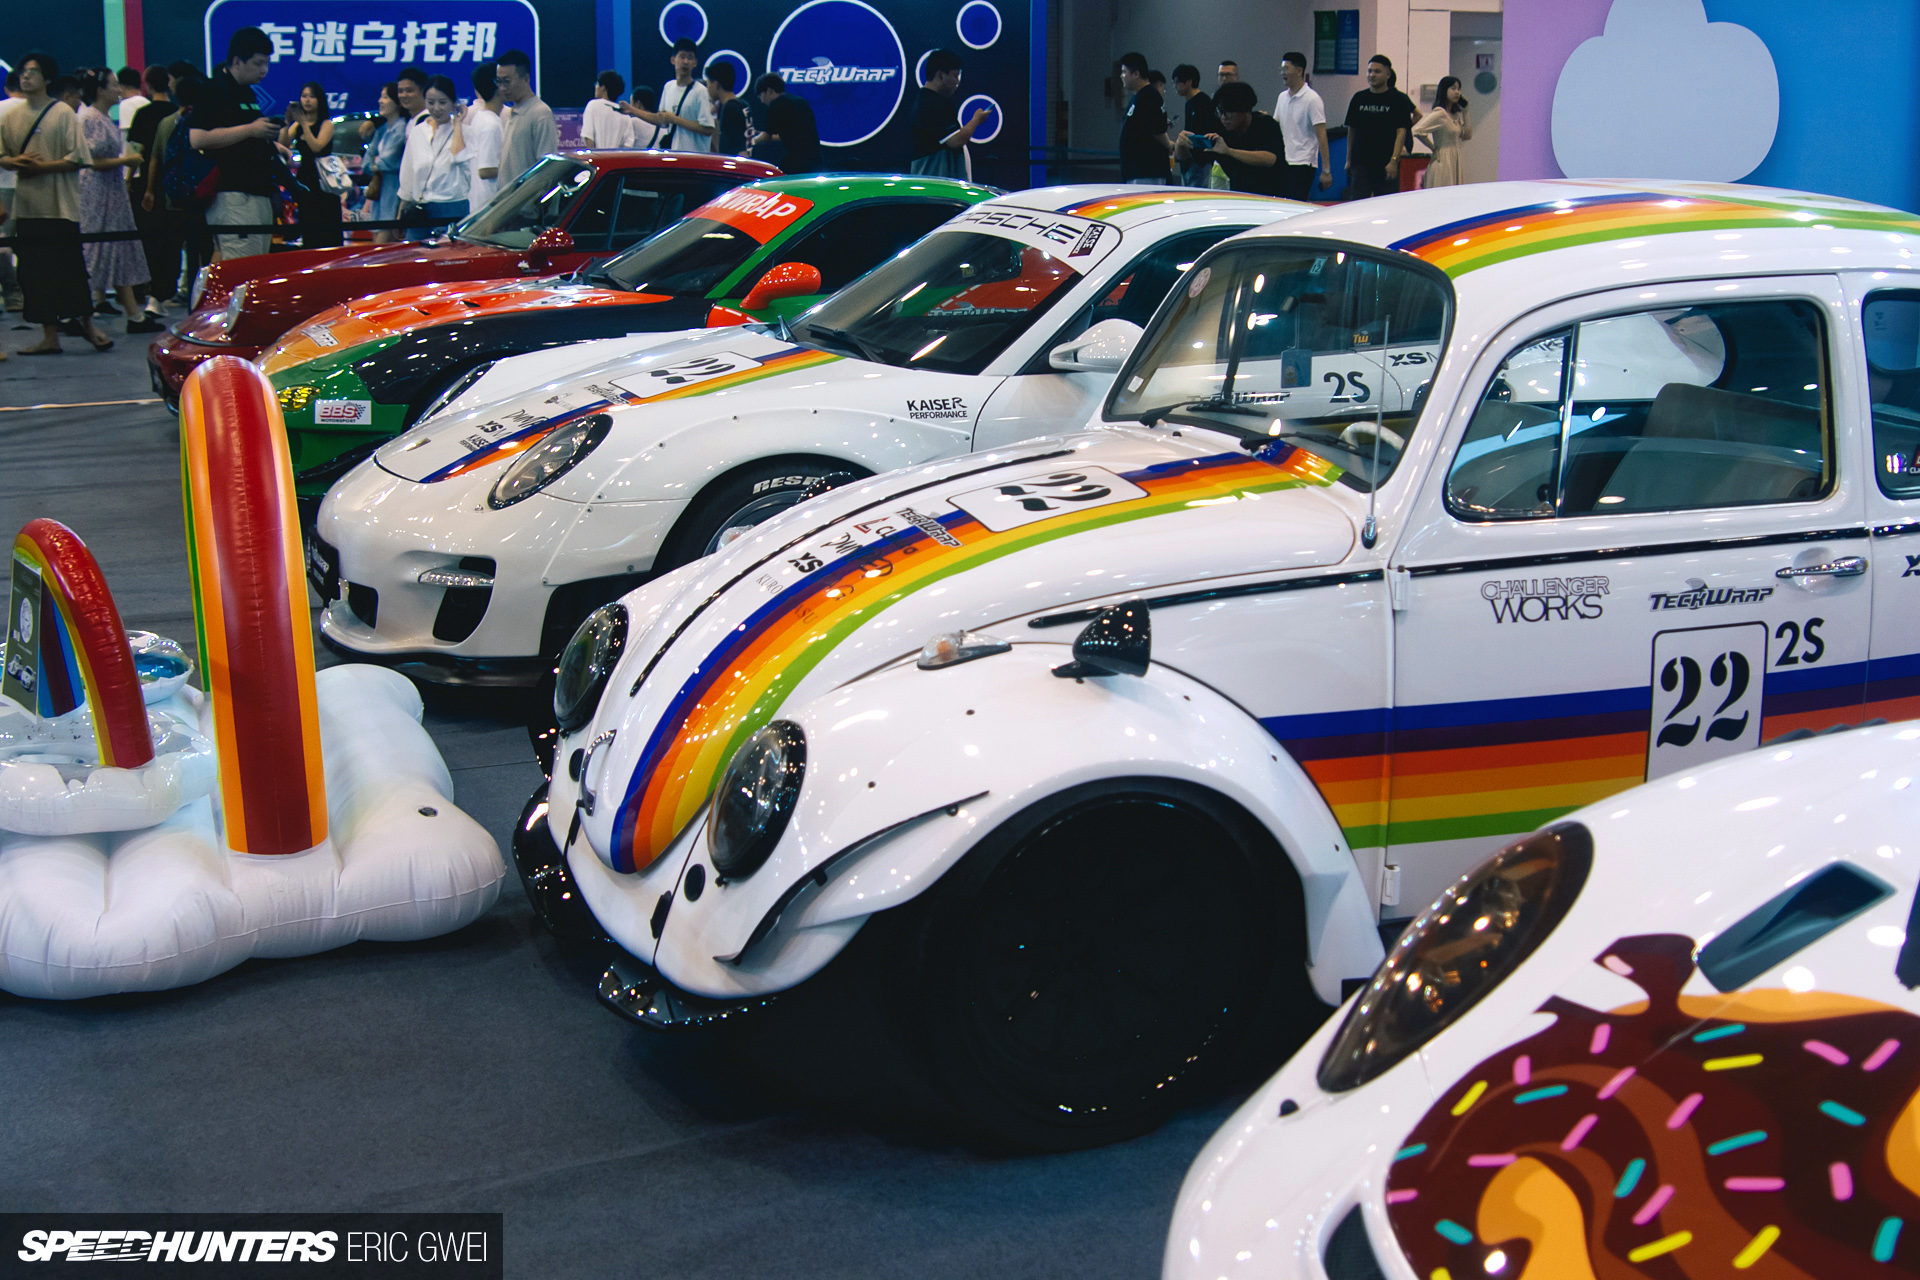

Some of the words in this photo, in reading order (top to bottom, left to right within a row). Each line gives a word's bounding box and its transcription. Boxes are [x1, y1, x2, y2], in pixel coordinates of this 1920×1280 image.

[258, 21, 497, 63] 车迷乌托邦
[320, 405, 358, 418] BBS
[906, 396, 968, 411] KAISER
[909, 410, 968, 419] PERFORMANCE
[994, 473, 1112, 512] 22
[1481, 576, 1611, 601] CHALLENGER
[1489, 594, 1603, 624] WORKS
[1774, 617, 1826, 667] 2S
[1656, 651, 1751, 748] 22
